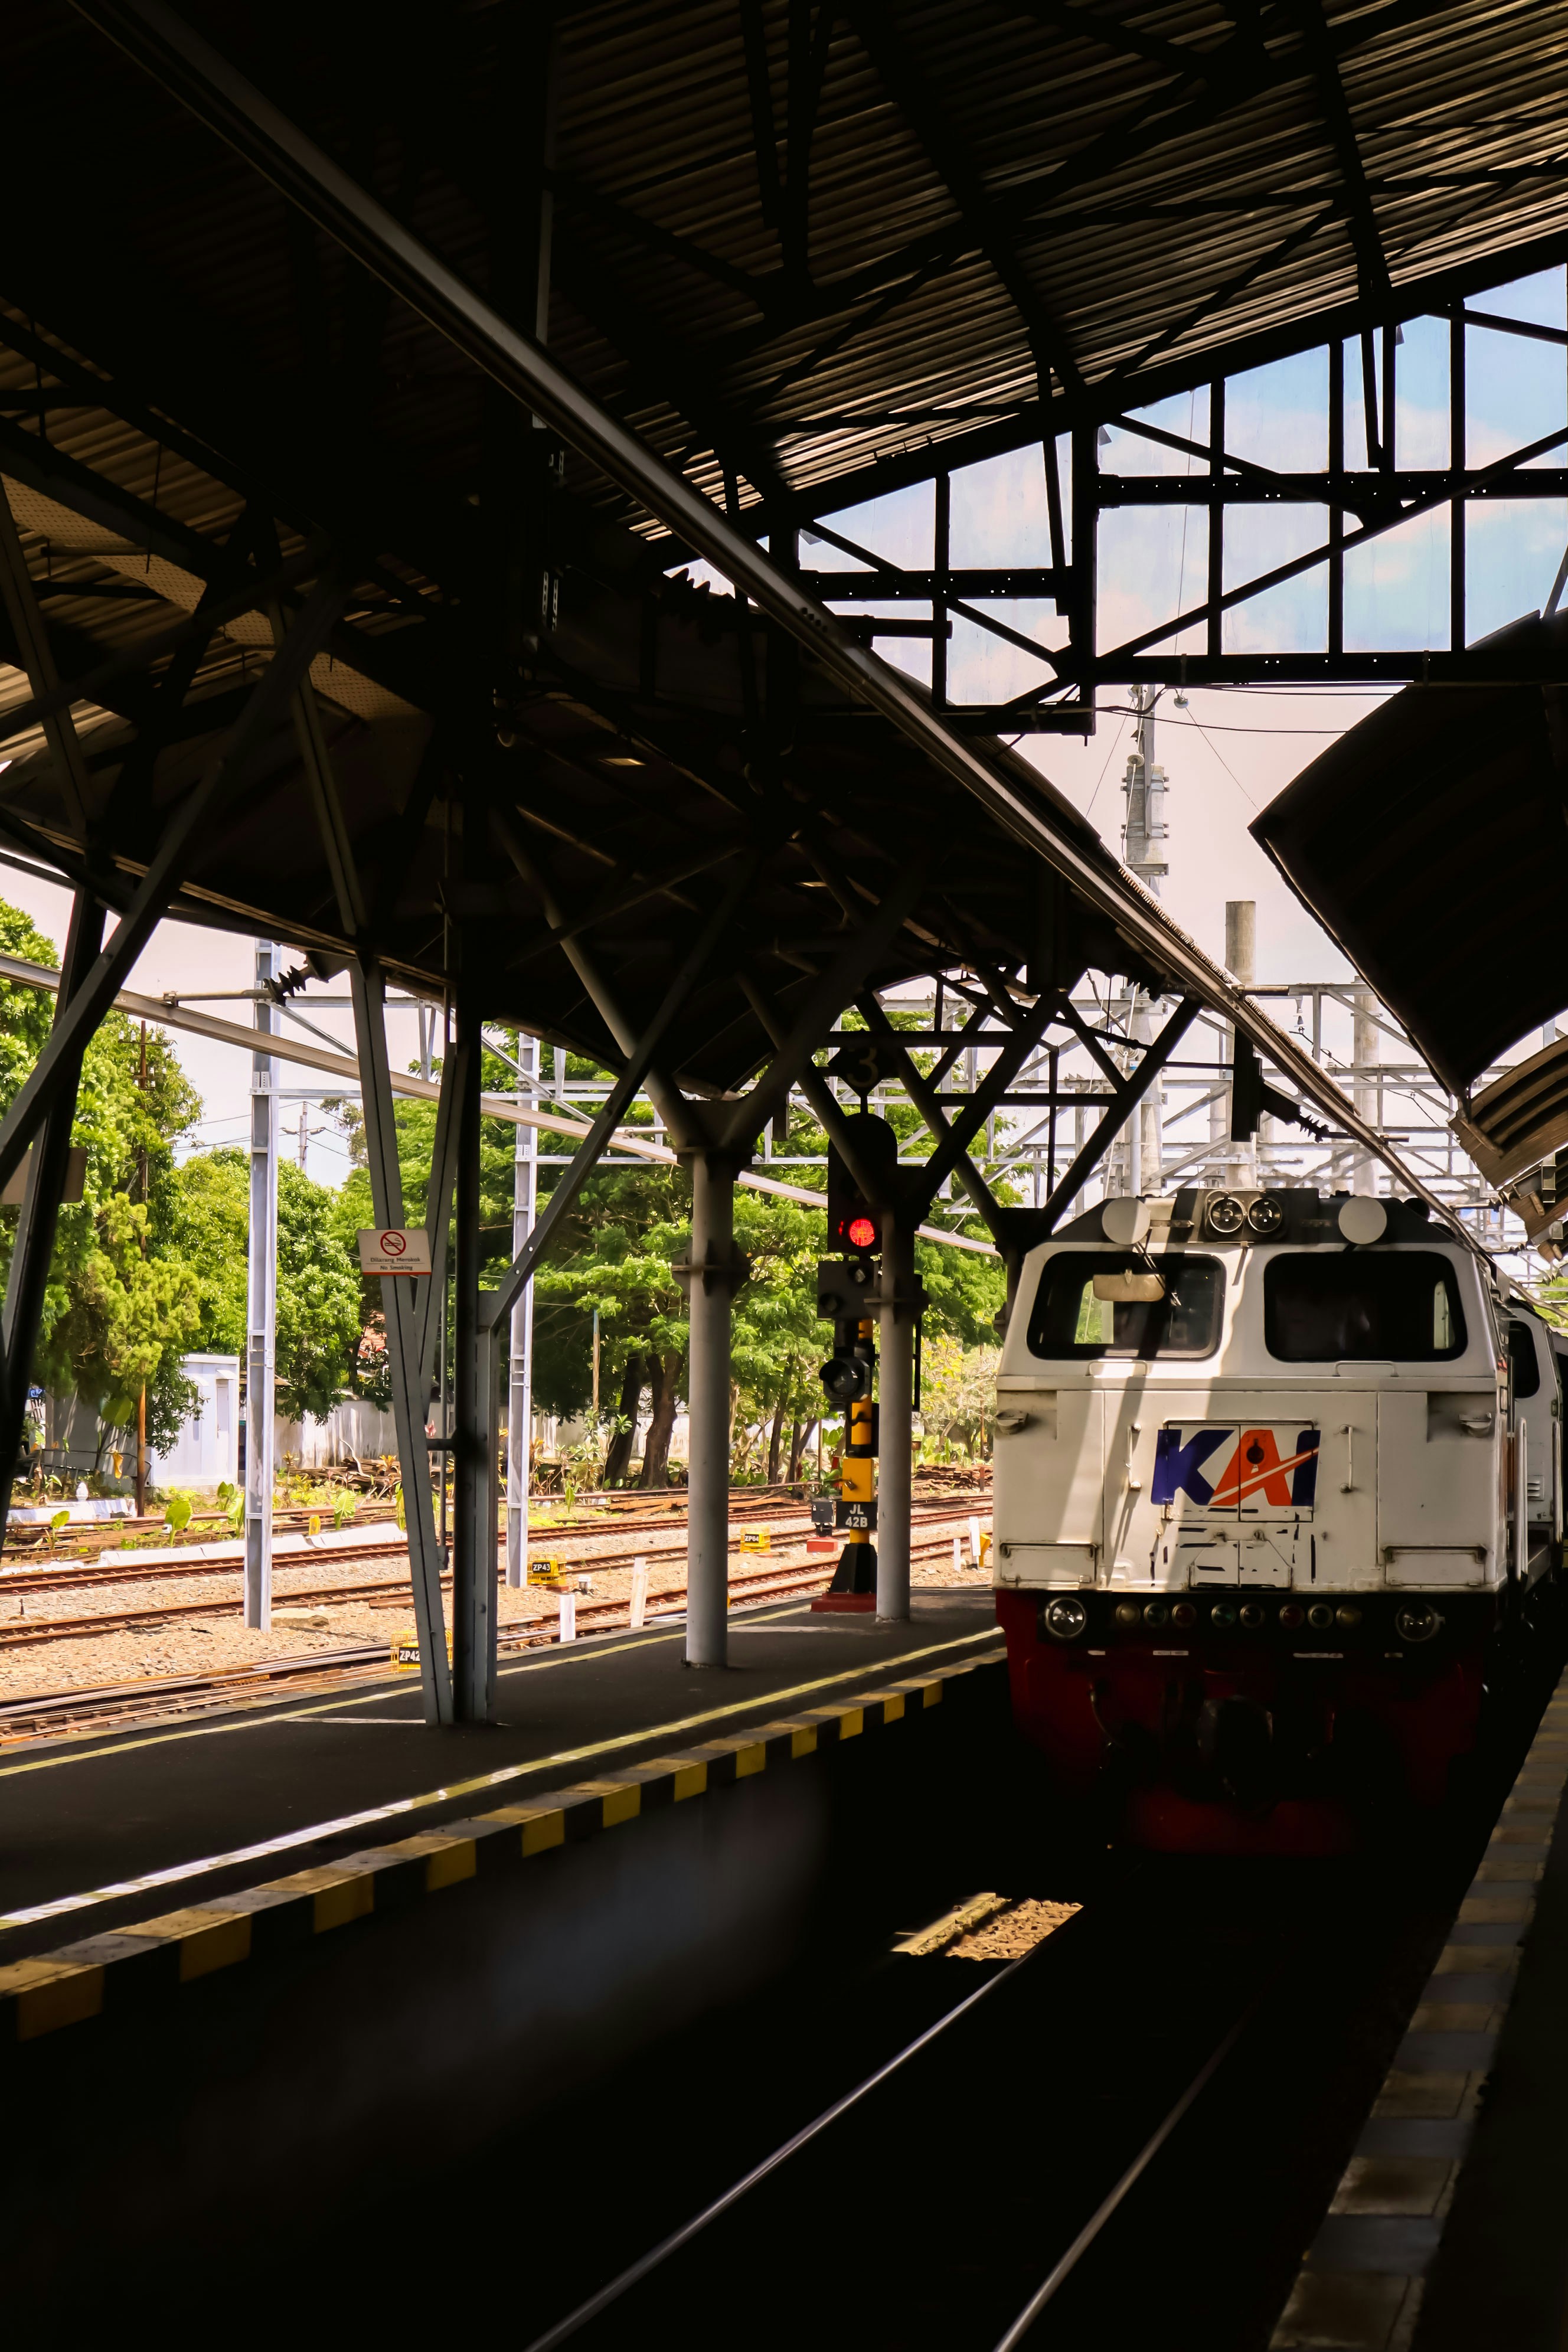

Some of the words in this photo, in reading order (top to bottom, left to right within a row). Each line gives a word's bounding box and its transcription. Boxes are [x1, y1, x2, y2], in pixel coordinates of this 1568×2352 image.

[846, 1047, 878, 1087] 3
[1151, 1429, 1321, 1506] KAI
[850, 1504, 864, 1515] JL
[845, 1516, 868, 1527] 42B
[533, 1563, 550, 1572] ZP43
[399, 1650, 420, 1661] ZP42
